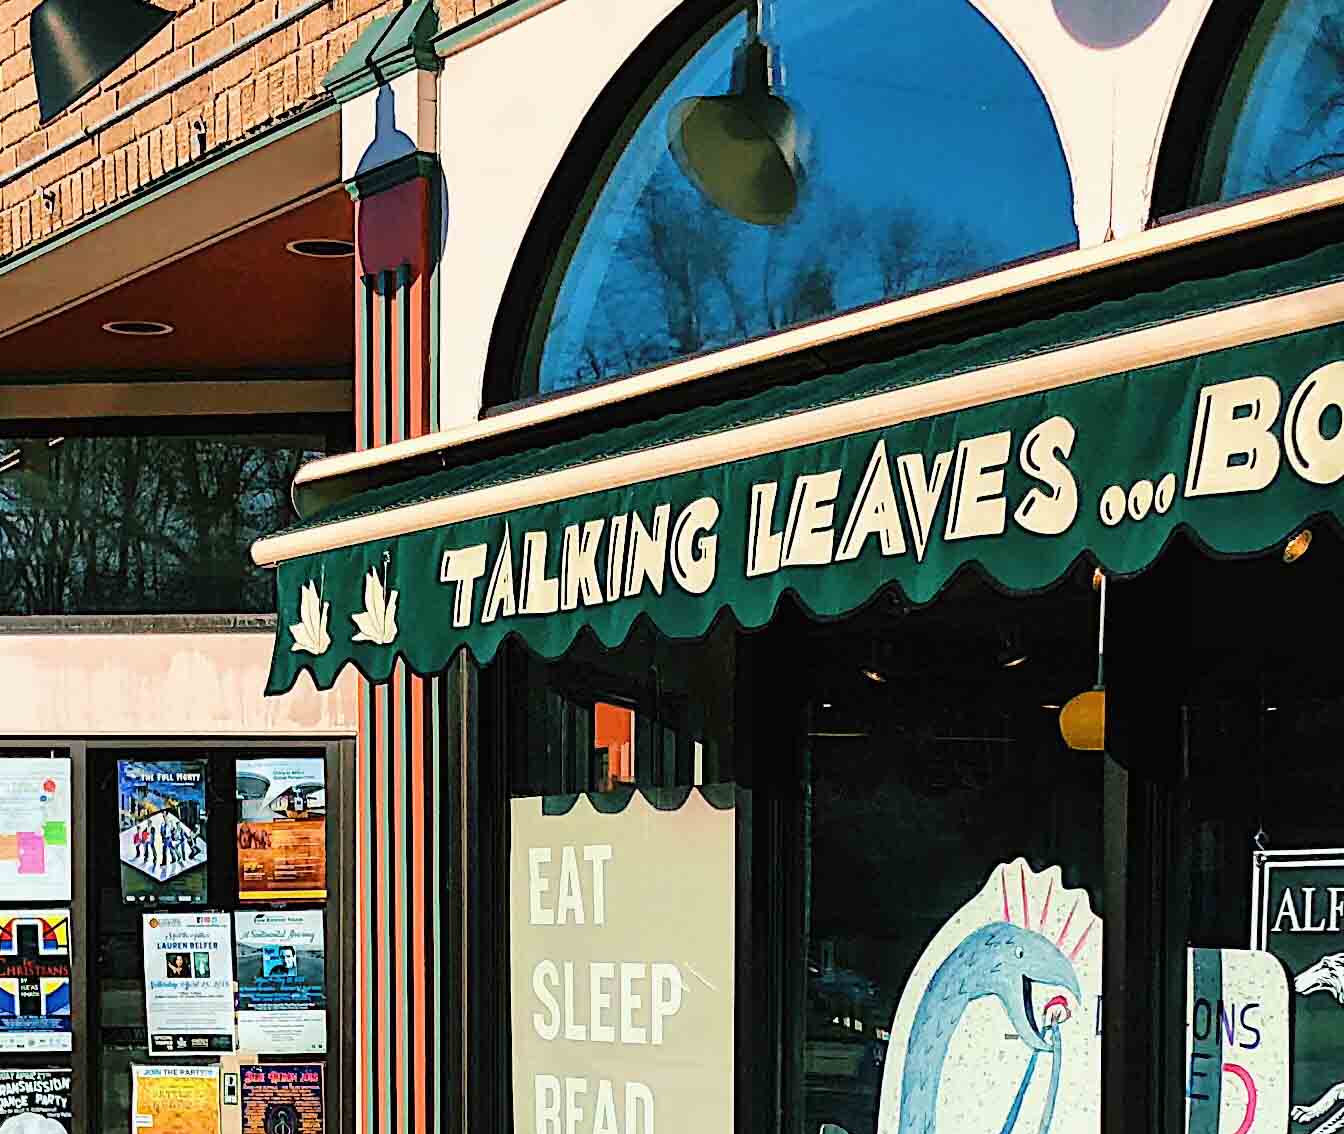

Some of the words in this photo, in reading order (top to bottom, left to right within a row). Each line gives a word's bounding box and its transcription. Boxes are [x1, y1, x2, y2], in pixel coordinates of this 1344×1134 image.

[440, 496, 720, 628] TALKING
[176, 772, 201, 782] MONTY
[528, 844, 612, 926] EAT
[157, 942, 188, 950] LAUREN
[532, 960, 682, 1044] SLEEP
[35, 1093, 68, 1109] PARTY
